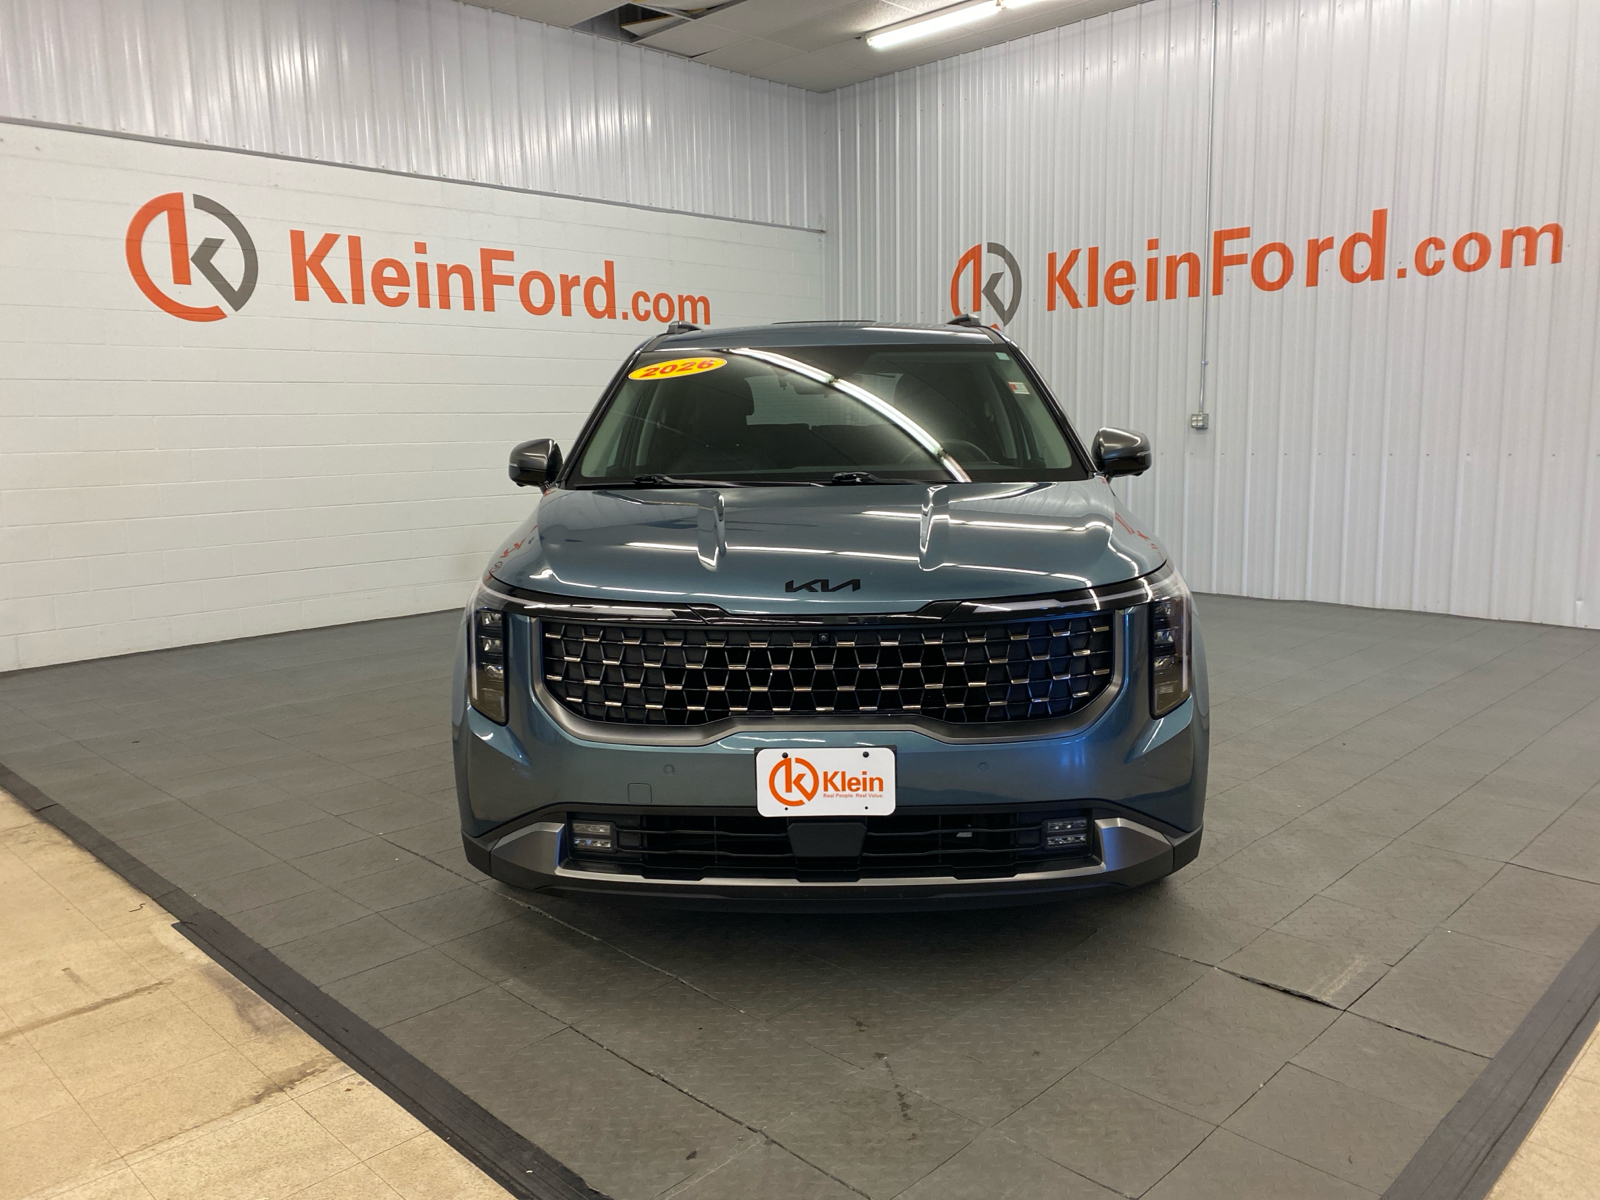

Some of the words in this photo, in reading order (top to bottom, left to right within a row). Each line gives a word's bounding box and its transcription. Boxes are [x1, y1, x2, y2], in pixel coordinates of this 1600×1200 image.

[289, 228, 711, 325] KleinFord.com
[1047, 208, 1564, 312] KleinFord.com
[639, 359, 716, 379] 2026
[823, 771, 884, 792] Klein
